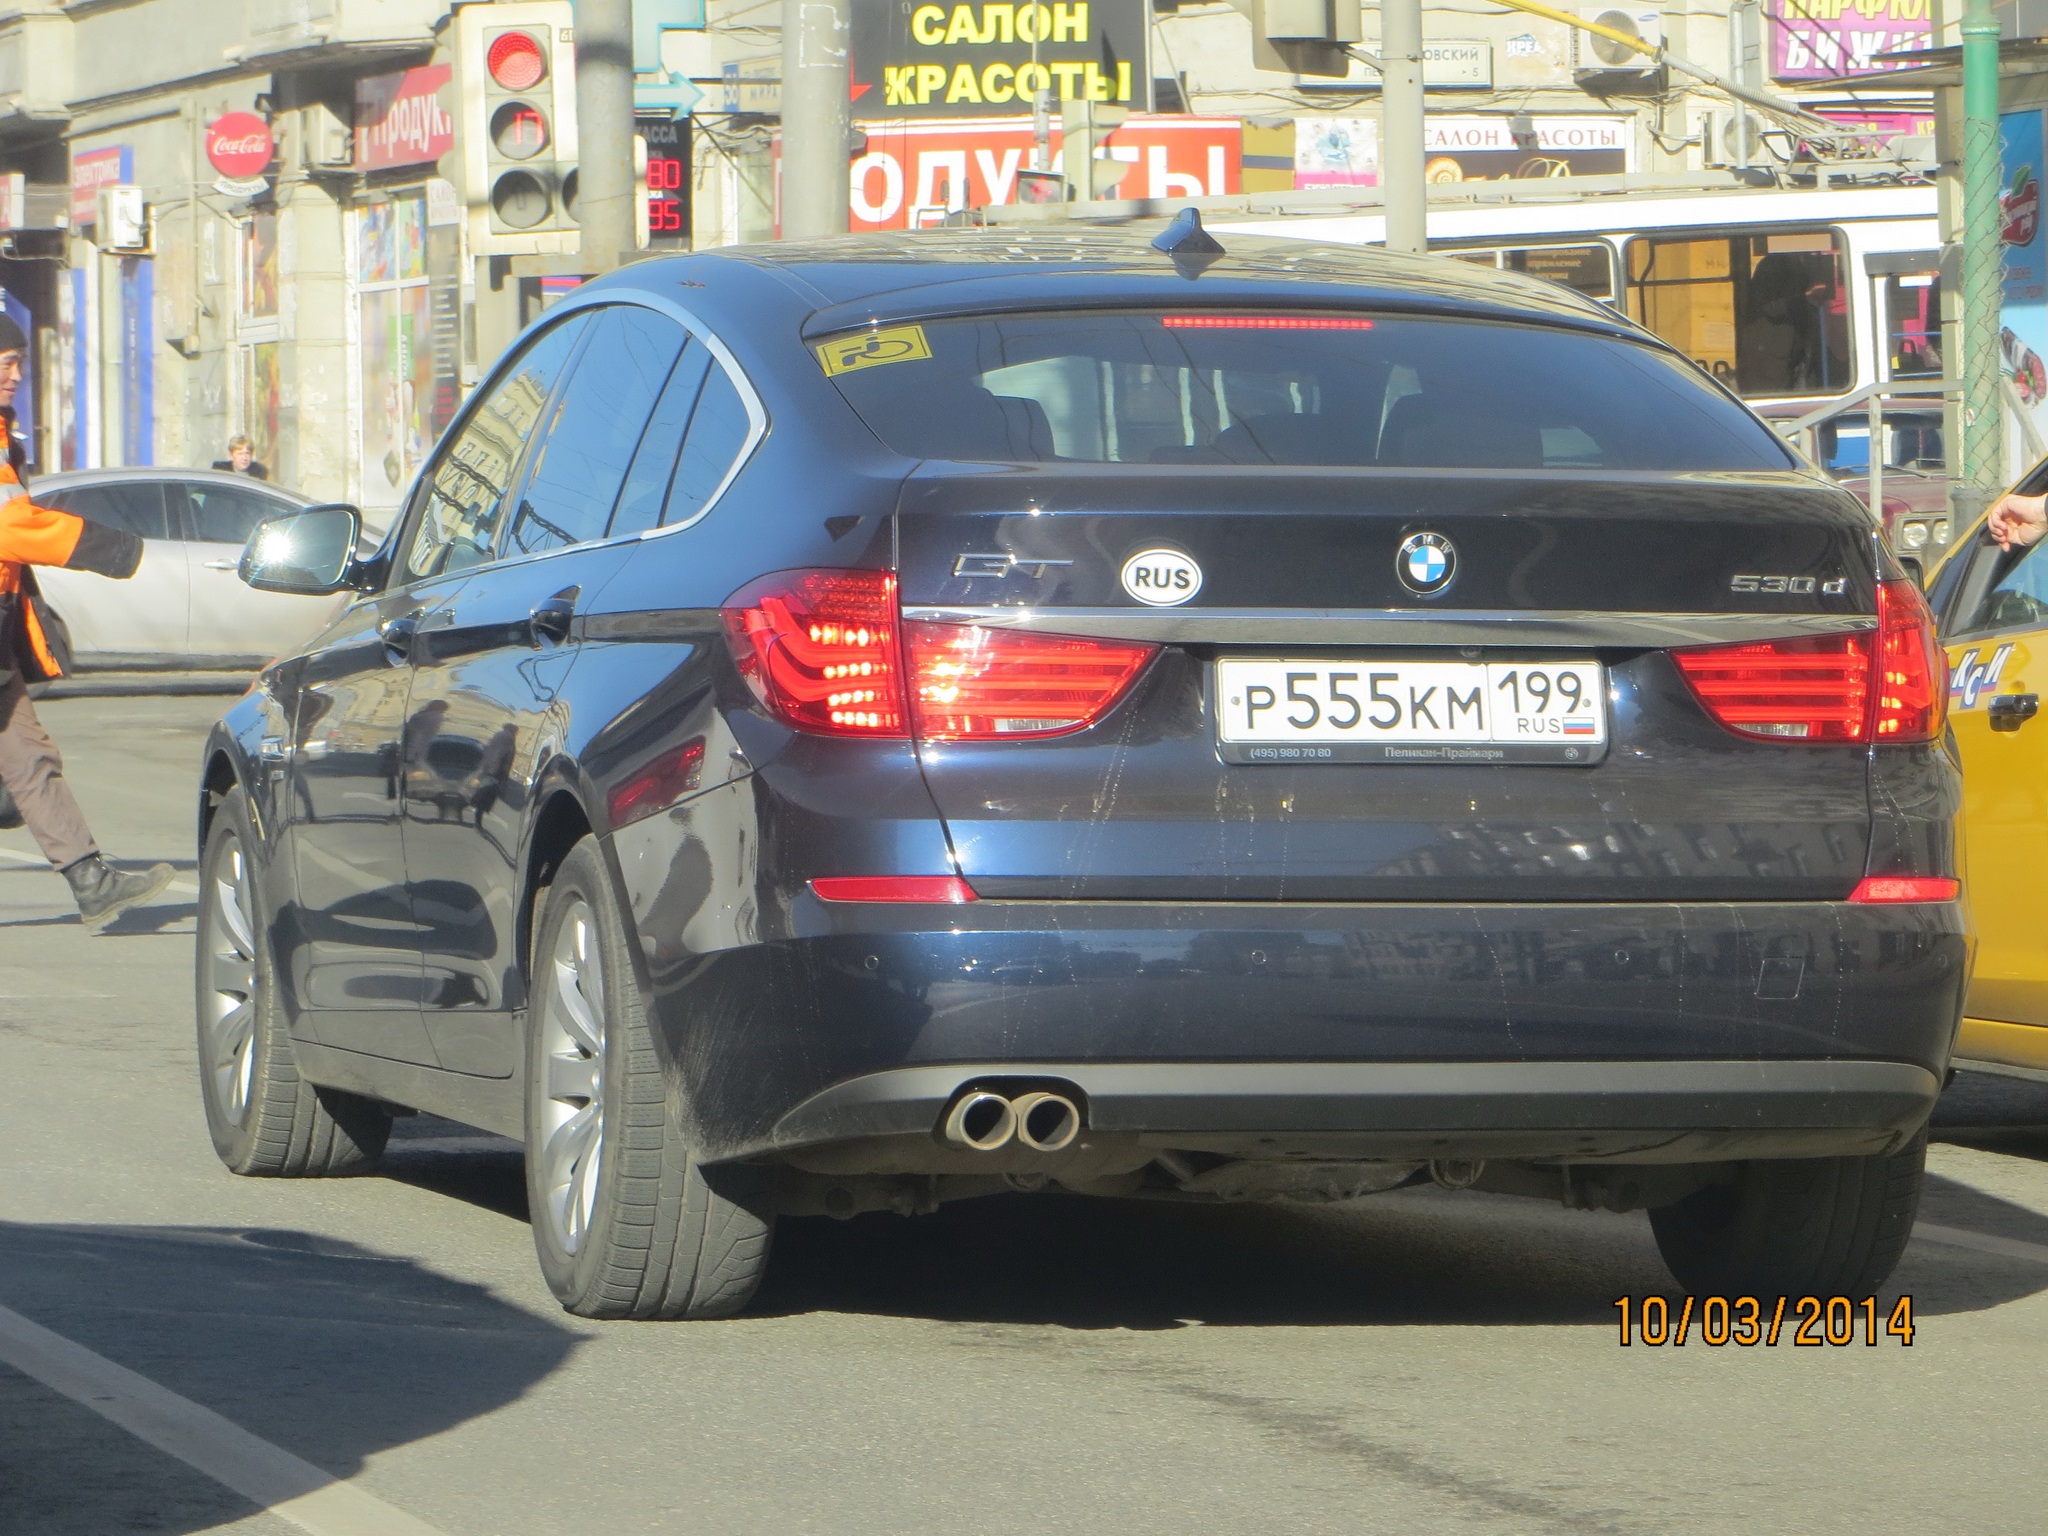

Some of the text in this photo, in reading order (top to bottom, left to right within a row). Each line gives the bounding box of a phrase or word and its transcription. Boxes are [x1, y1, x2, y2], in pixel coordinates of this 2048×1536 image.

[912, 3, 1089, 46] САЛОН
[1783, 0, 1932, 20] ПАРФЮ
[884, 62, 1132, 106] КРАСОТЫ
[513, 109, 545, 145] 17
[1424, 129, 1499, 146] САЛОН
[1402, 534, 1453, 554] BMW
[1134, 566, 1190, 590] RUS
[1952, 643, 2015, 707] КСИ
[1246, 671, 1484, 731] Р555КМ
[1498, 670, 1582, 714] 199
[1517, 717, 1561, 734] RUS
[1250, 748, 1332, 759] (495) 980 70 80
